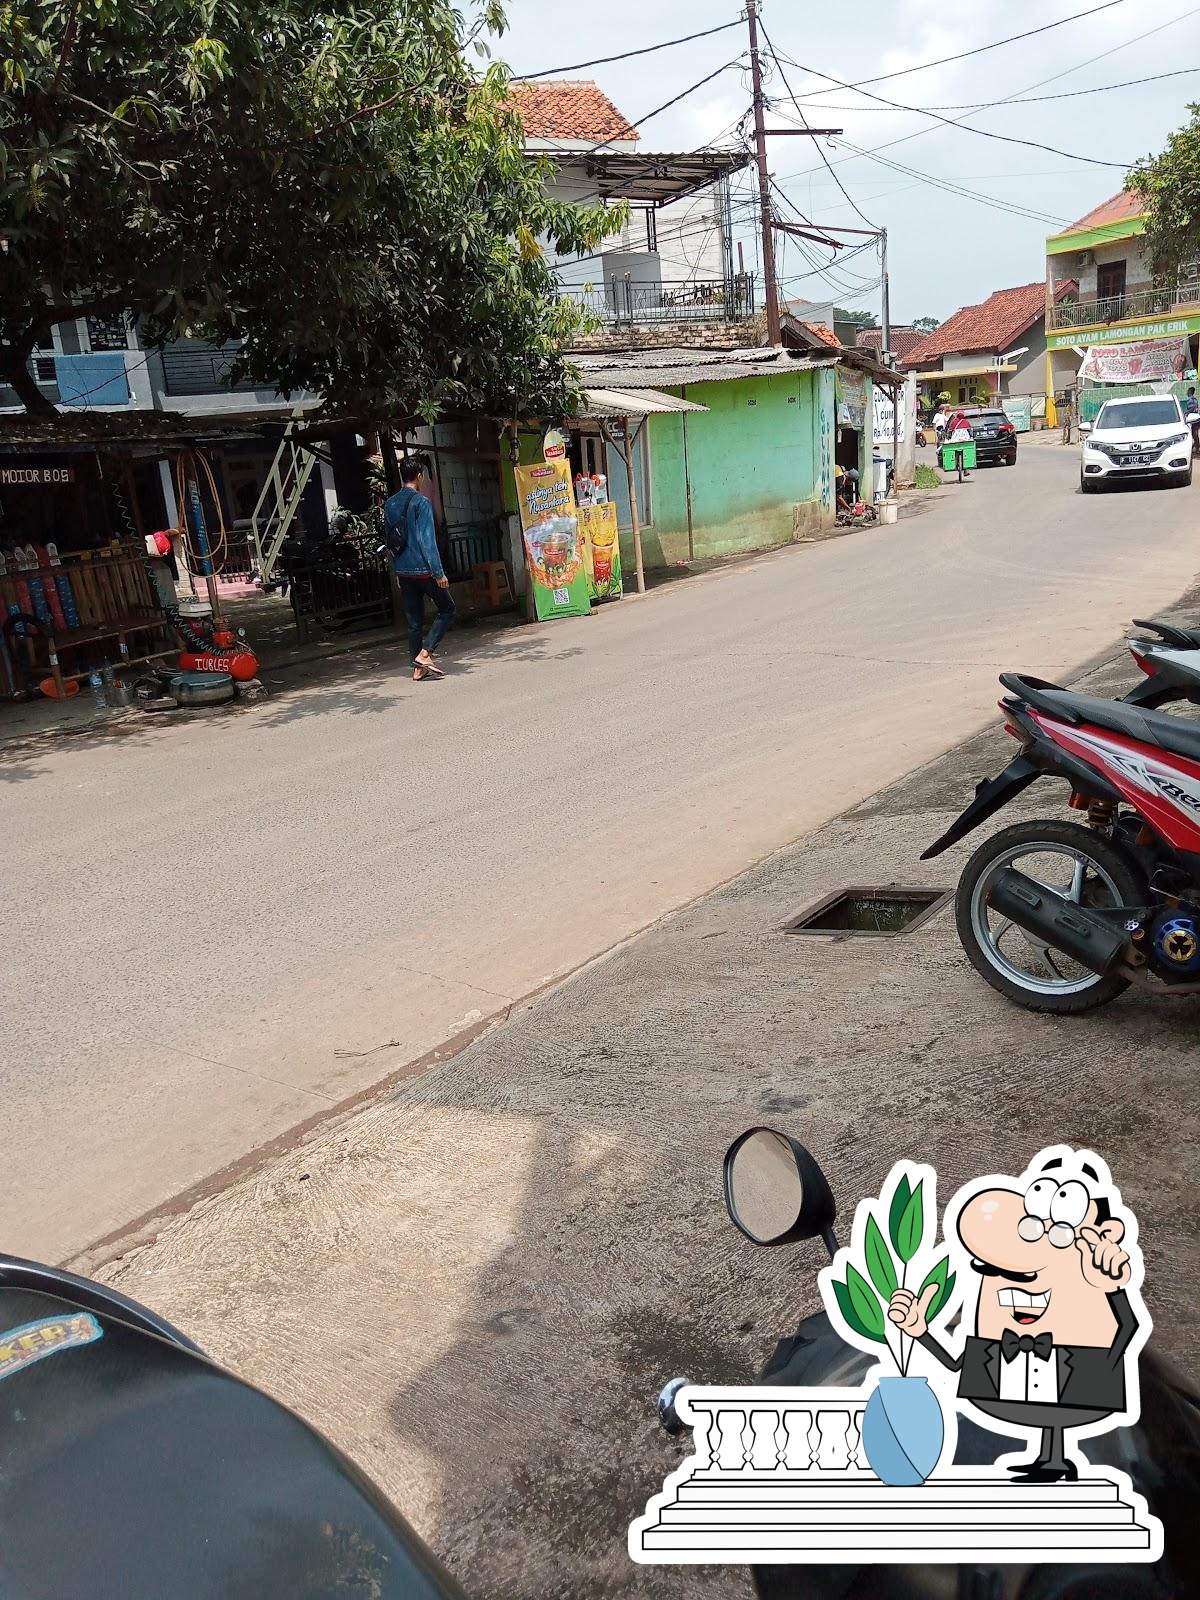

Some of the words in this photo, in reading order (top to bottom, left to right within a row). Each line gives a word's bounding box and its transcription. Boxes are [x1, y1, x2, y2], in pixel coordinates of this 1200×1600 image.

[1056, 337, 1075, 346] SOTO
[1077, 333, 1098, 343] AYAM
[1100, 326, 1145, 341] LAMONGAN
[1147, 324, 1165, 335] PAK
[1167, 320, 1188, 332] ERIK
[881, 410, 894, 420] CUM
[43, 469, 69, 482] BOS
[555, 479, 568, 492] teh
[528, 495, 570, 514] Nusantara
